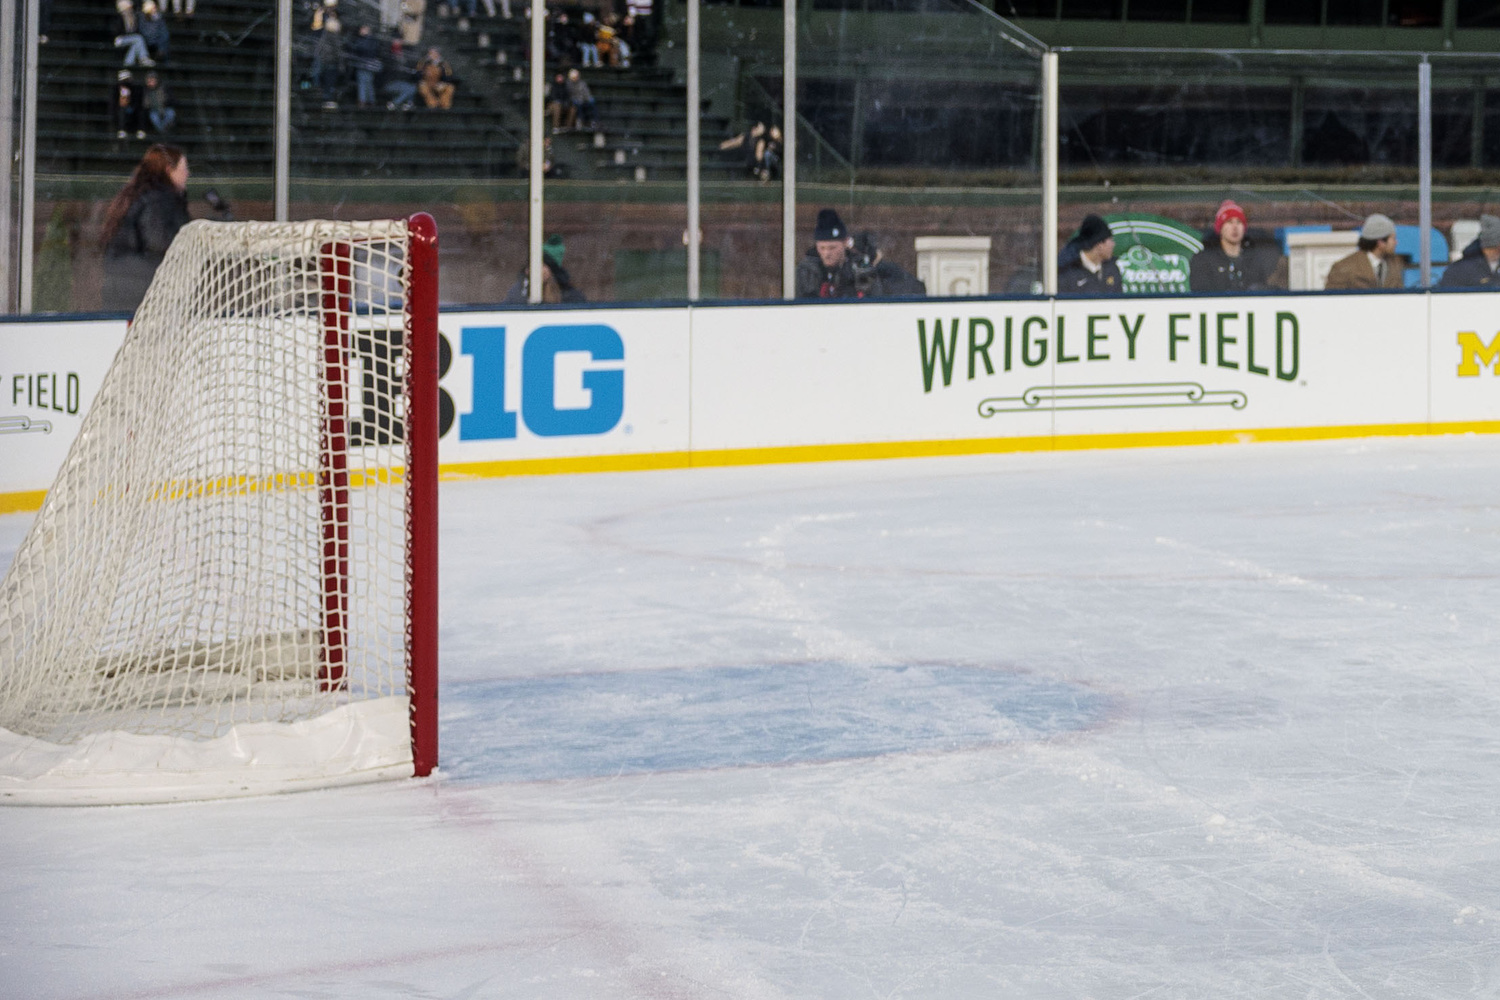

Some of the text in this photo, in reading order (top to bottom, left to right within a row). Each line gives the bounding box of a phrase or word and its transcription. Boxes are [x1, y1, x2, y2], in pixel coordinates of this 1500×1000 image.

[917, 311, 1301, 394] WRIGLEY FIELD
[13, 372, 79, 415] FIELD
